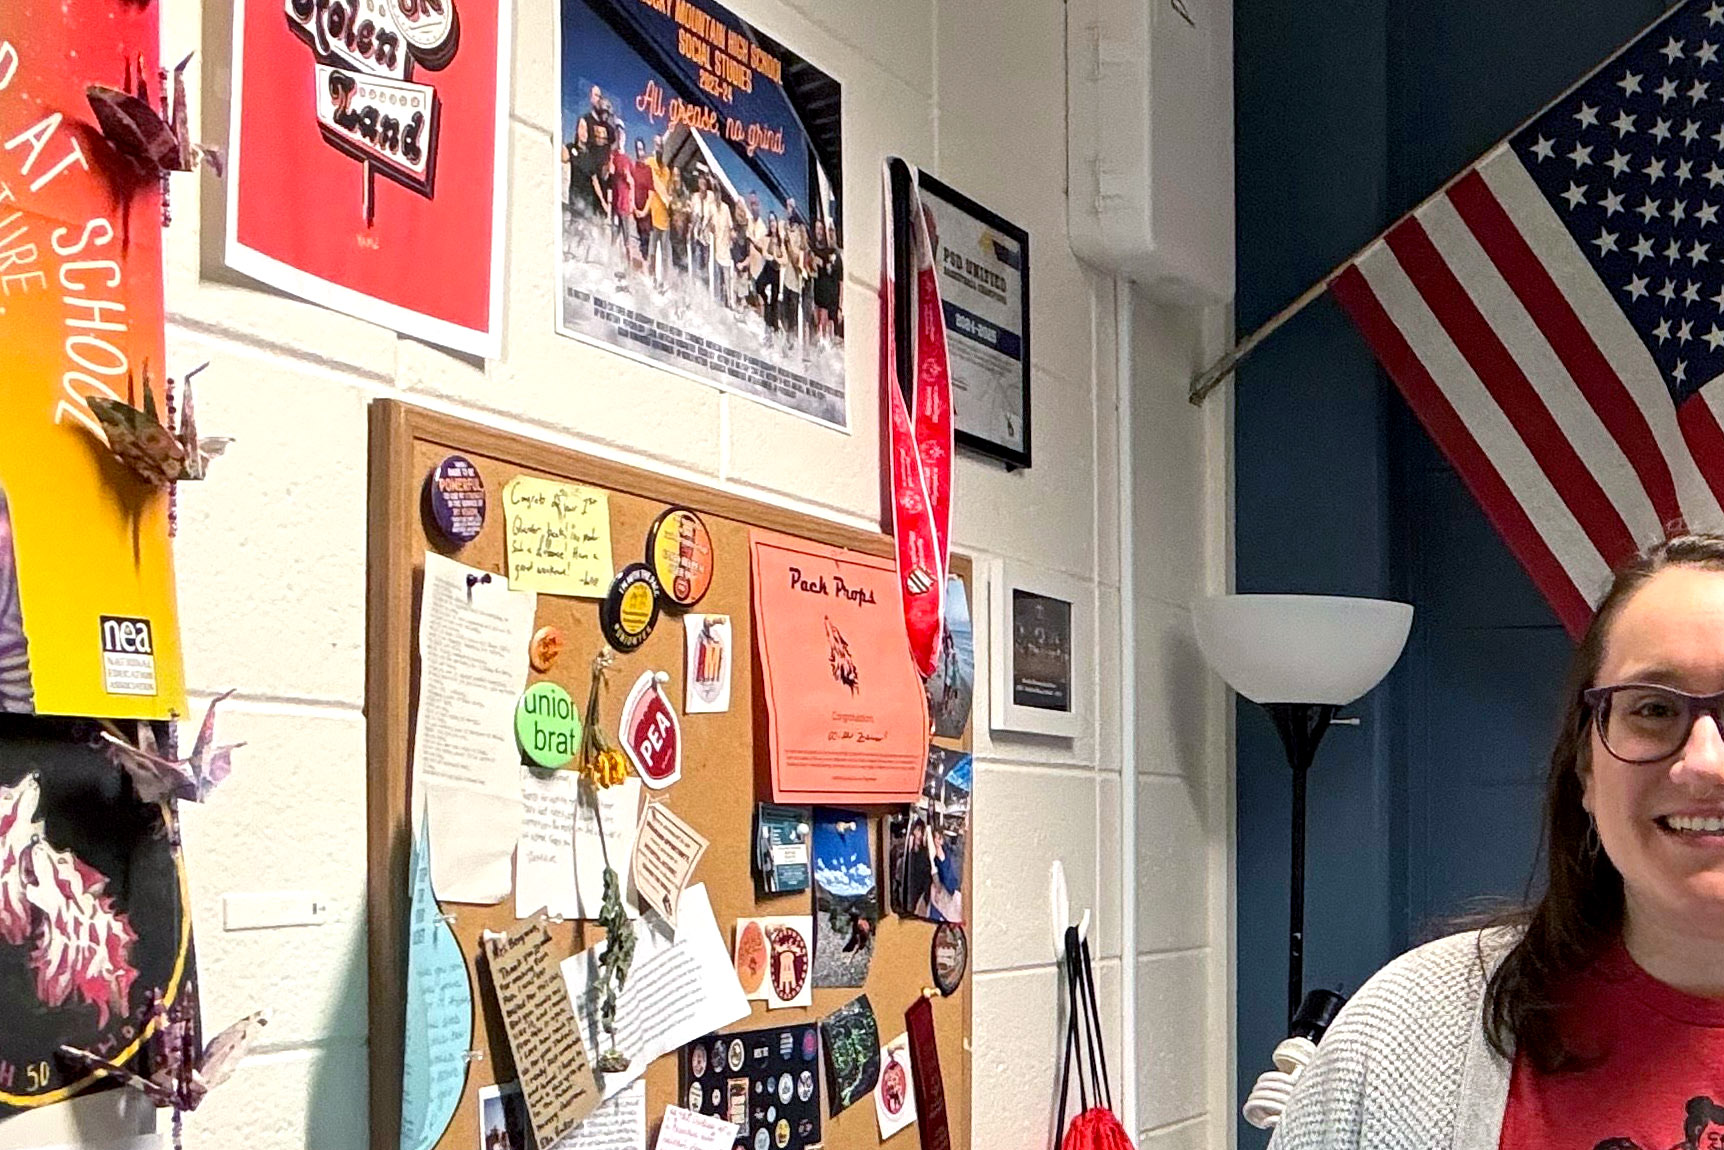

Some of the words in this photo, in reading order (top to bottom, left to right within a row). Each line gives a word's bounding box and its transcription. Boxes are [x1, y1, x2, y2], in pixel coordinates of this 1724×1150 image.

[675, 0, 727, 49] MOUNTAIN
[727, 29, 749, 64] HIGH
[750, 43, 783, 85] SCHOOL
[678, 28, 713, 70] SOCIAL
[714, 50, 753, 93] STUDIES
[636, 80, 665, 124] All
[699, 69, 733, 104] 2023-24
[329, 70, 424, 165] Land
[4, 112, 88, 192] AT
[789, 567, 829, 596] Pack
[833, 576, 876, 607] Props
[104, 620, 152, 652] nea
[534, 720, 576, 755] brat
[640, 711, 671, 767] PEA
